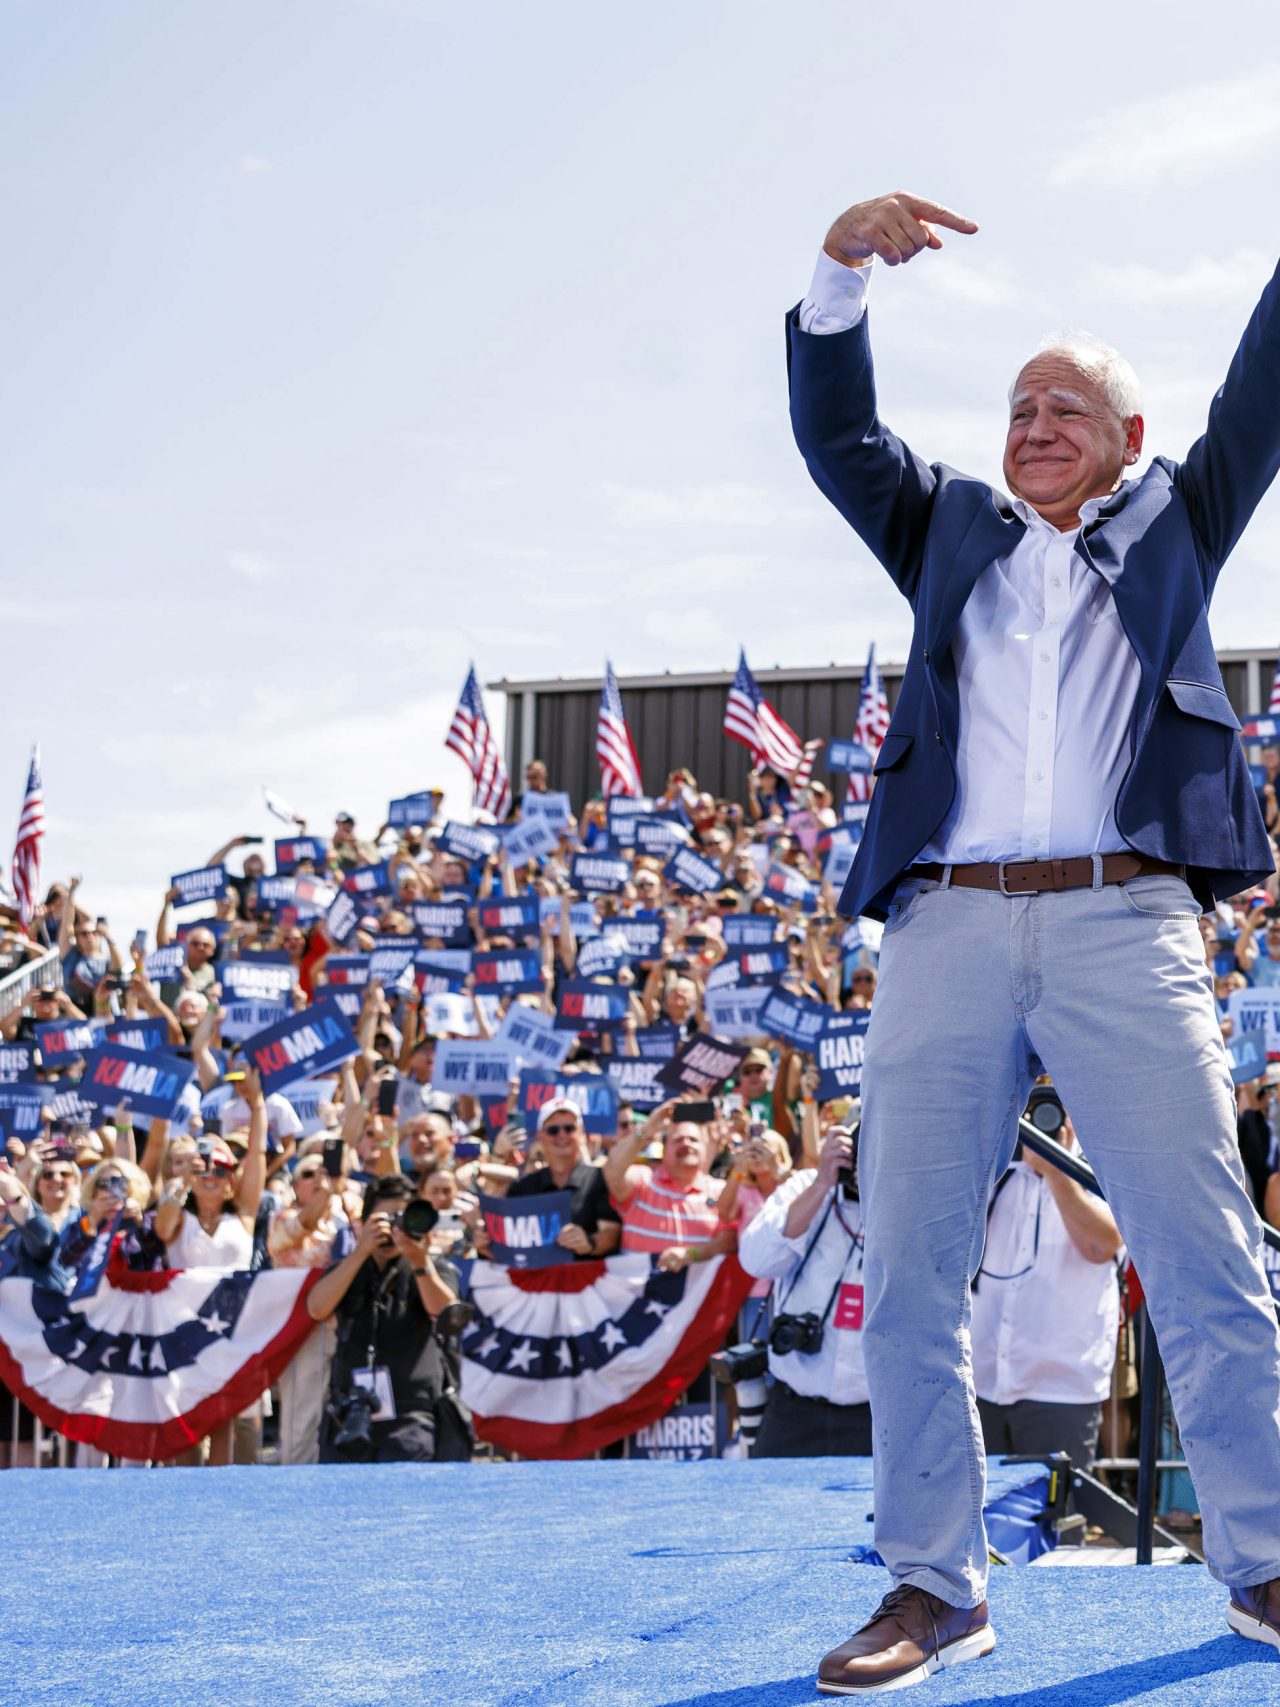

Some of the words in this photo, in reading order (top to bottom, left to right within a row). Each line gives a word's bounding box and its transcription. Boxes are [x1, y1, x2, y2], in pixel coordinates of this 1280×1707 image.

[223, 966, 292, 990] HARRIS
[1240, 1010, 1268, 1034] WE
[255, 1014, 346, 1077] KAMALA
[93, 1056, 179, 1100] KAMALA
[444, 1061, 470, 1081] WE
[475, 1061, 511, 1082] WIN
[484, 1211, 564, 1248] KAMALA
[635, 1414, 716, 1448] HARRIS
